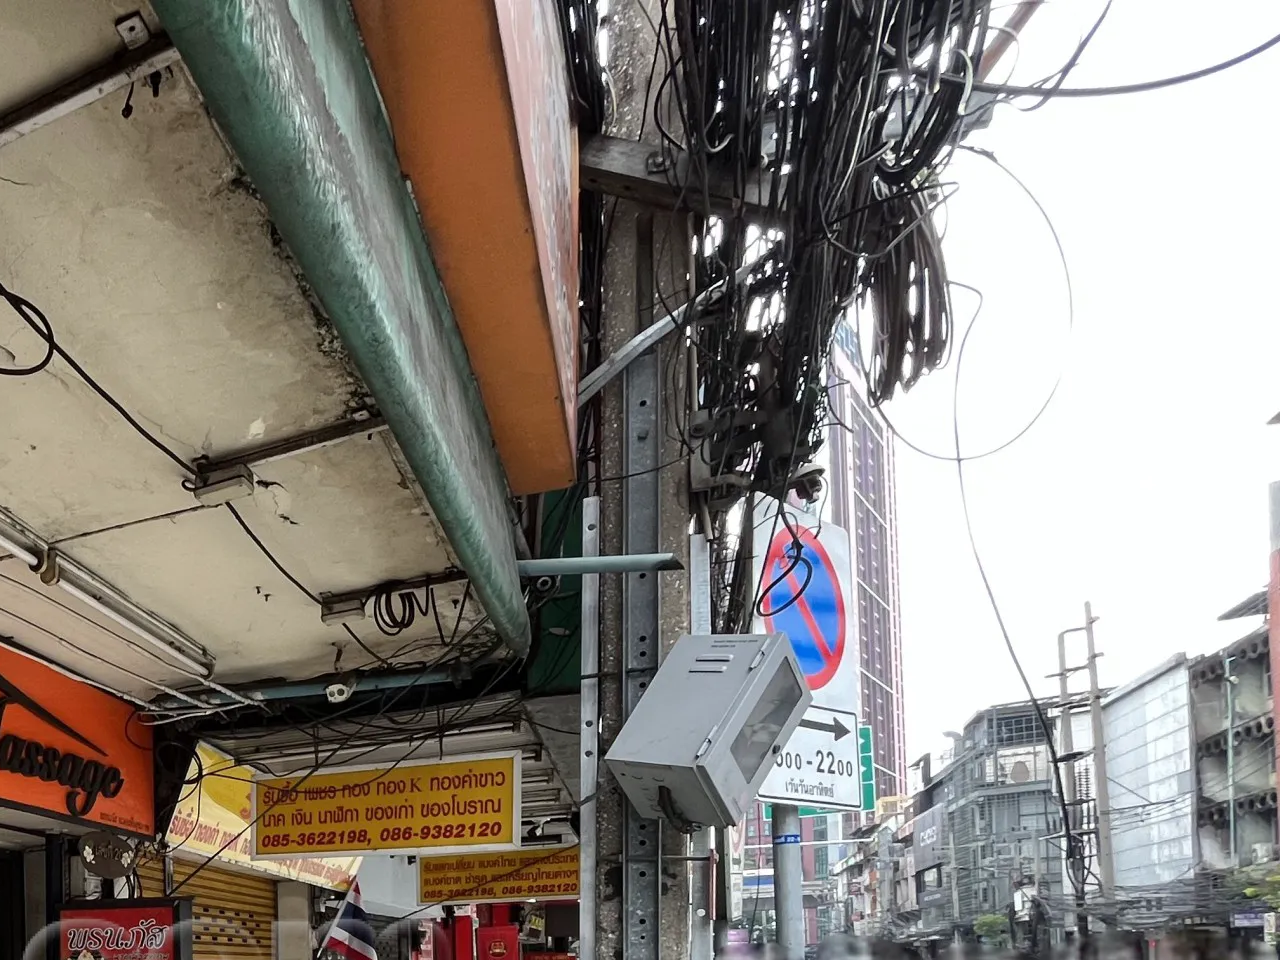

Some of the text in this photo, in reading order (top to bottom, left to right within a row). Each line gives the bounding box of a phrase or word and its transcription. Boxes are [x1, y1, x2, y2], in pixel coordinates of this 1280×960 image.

[342, 782, 370, 798] ทอง
[430, 769, 505, 791] ทองคำขาว
[263, 794, 502, 828] นาค เงิน นาฬิกา ของเก่า ของโบราณ
[261, 829, 371, 848] 085-3622198,
[380, 821, 502, 842] 086-9382120
[502, 883, 577, 895] 086-9382120
[67, 918, 169, 950] พรนภัส
